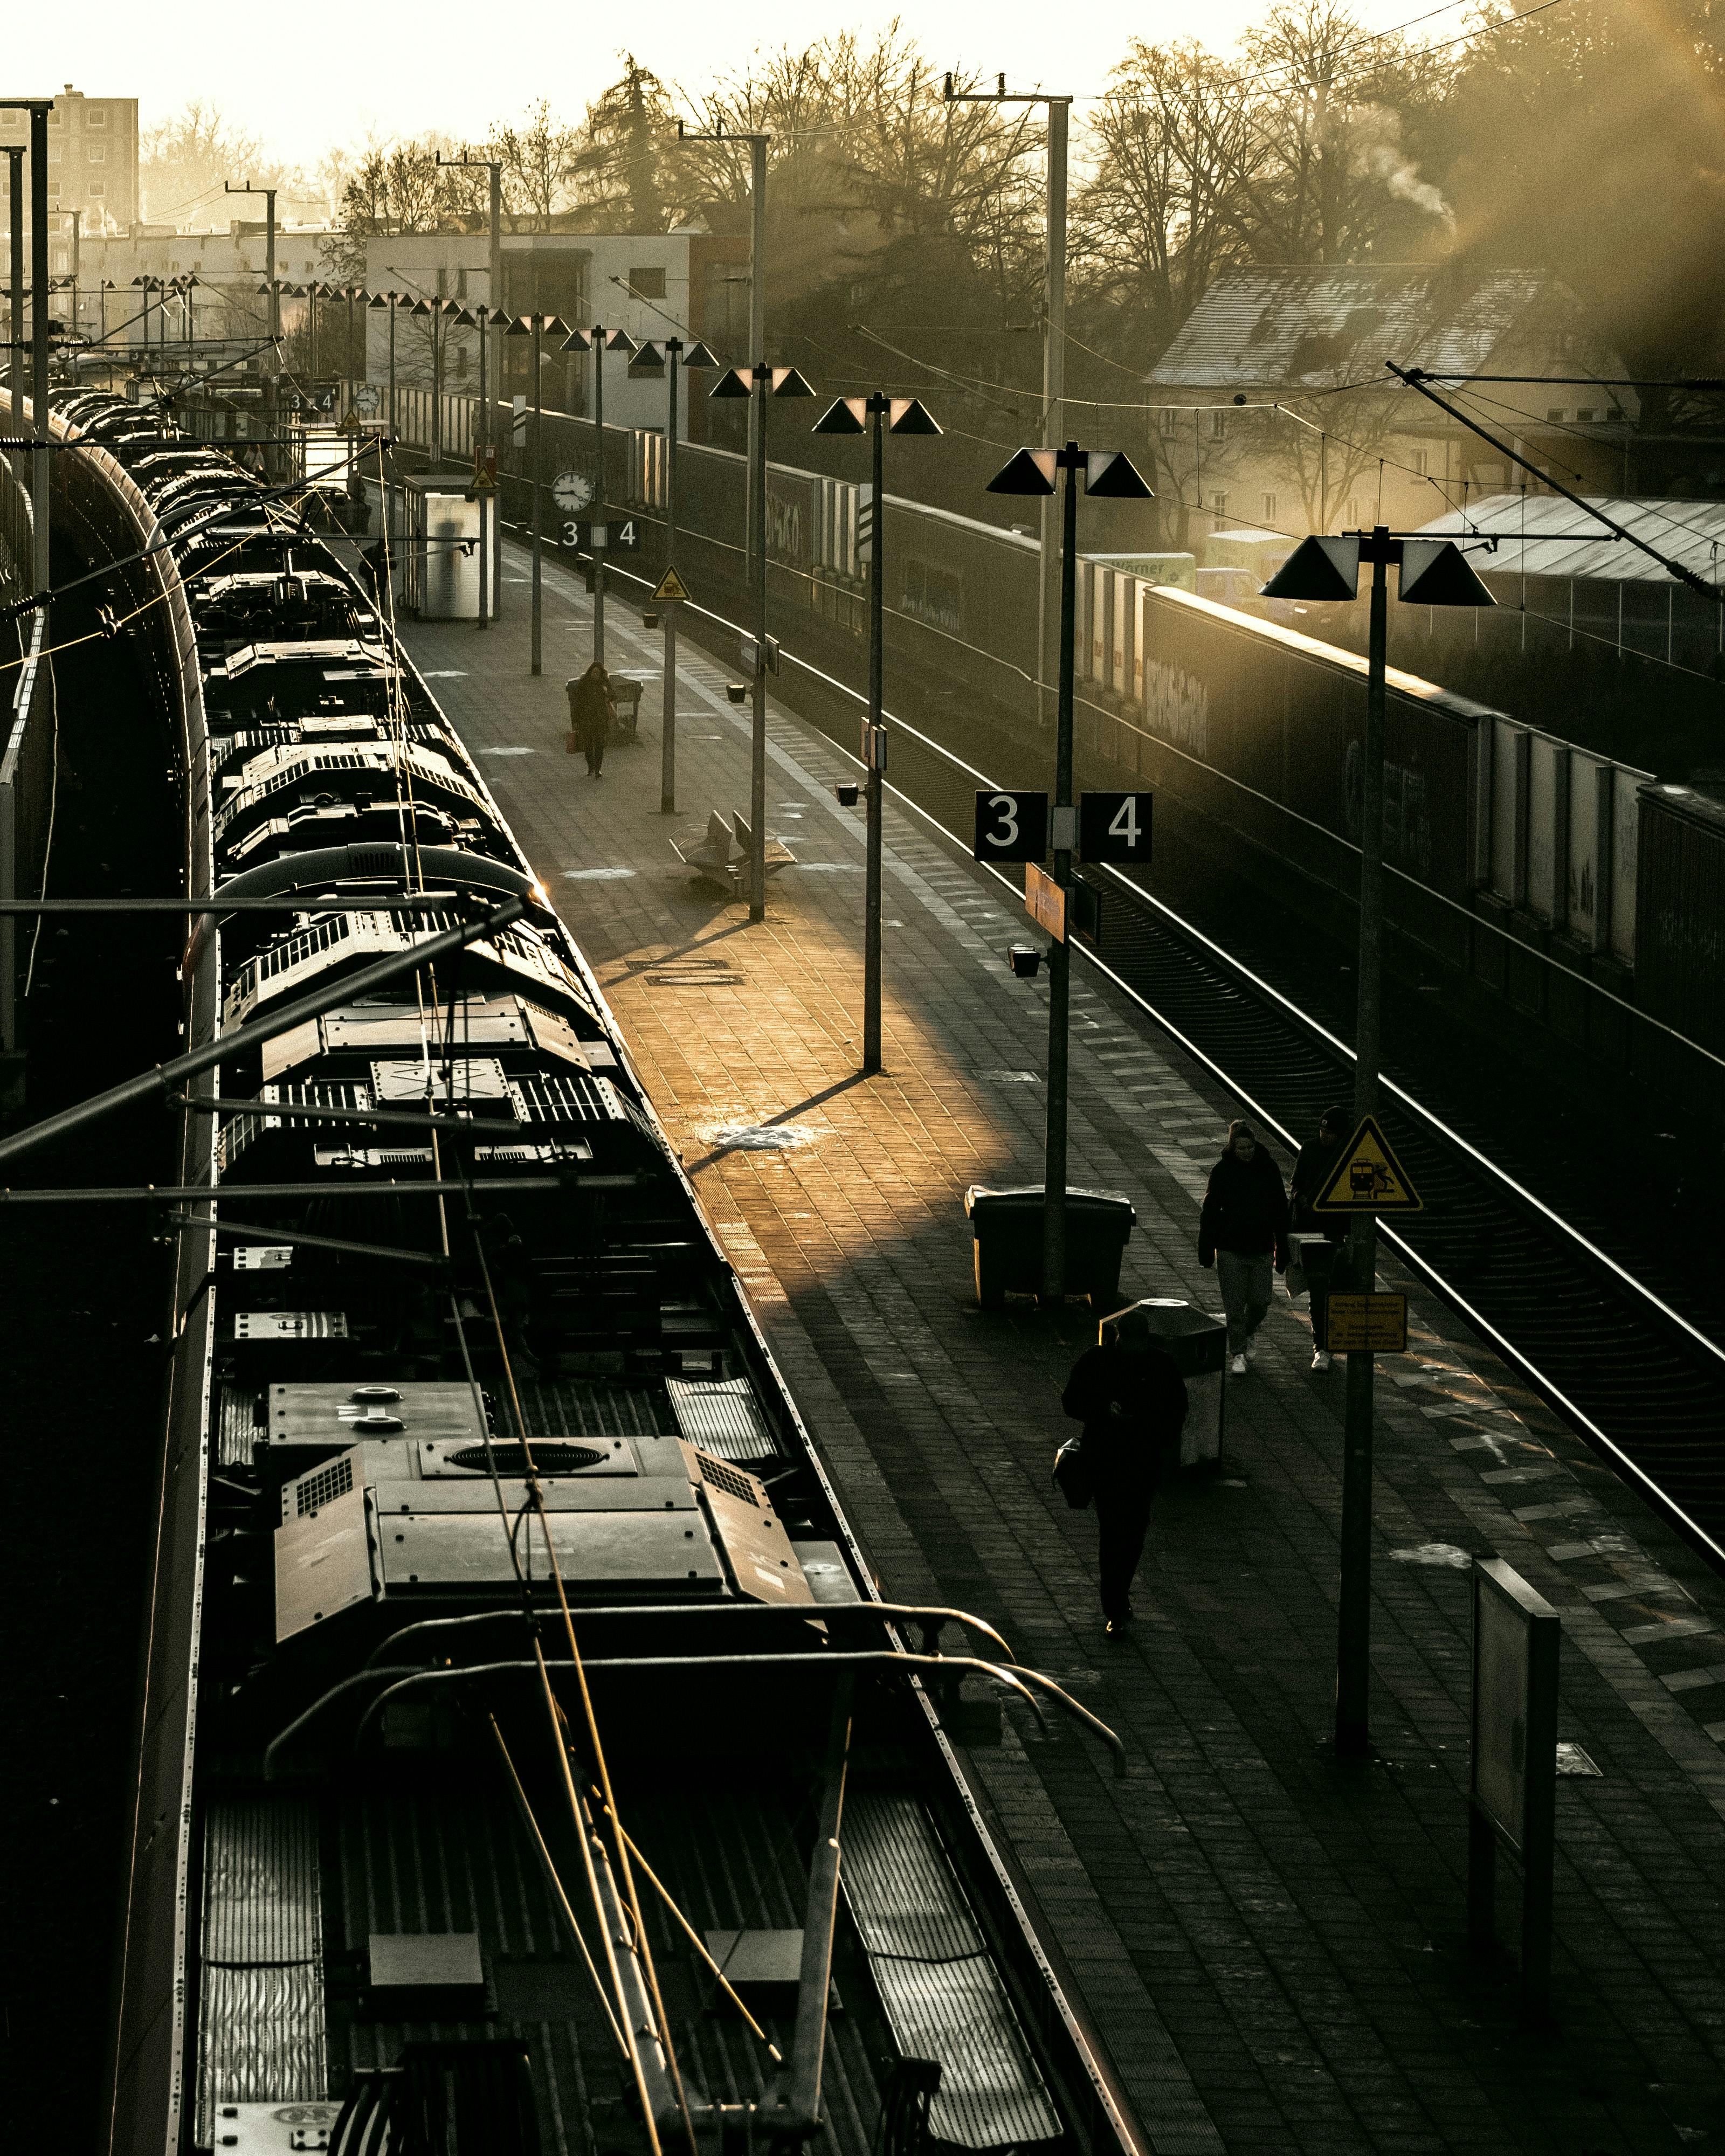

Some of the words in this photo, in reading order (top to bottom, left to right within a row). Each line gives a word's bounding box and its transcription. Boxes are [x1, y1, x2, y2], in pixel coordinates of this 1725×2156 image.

[292, 395, 300, 409] 3
[323, 395, 331, 409] 4
[562, 522, 578, 546] 3
[620, 522, 636, 545] 4
[985, 795, 1018, 846] 3
[1108, 797, 1141, 846] 4
